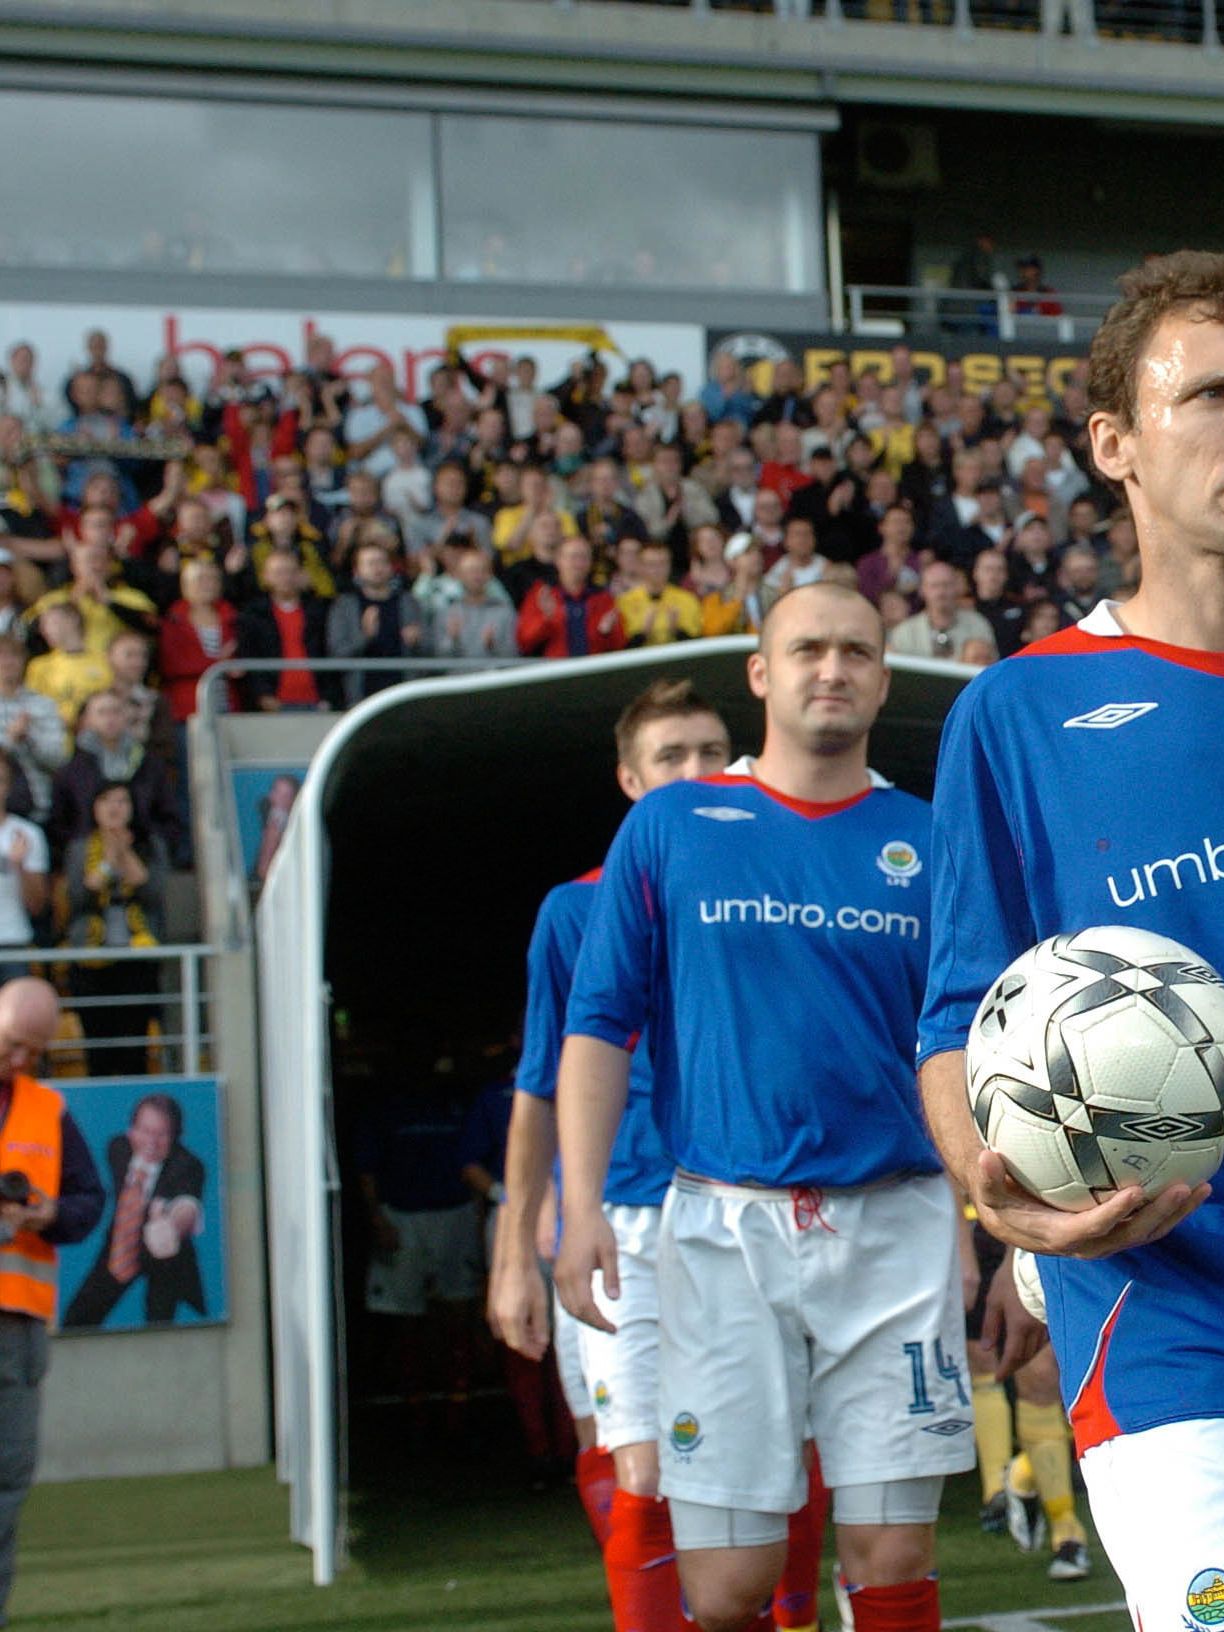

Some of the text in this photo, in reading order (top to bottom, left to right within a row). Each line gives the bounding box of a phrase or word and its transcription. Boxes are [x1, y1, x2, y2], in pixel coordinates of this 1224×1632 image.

[165, 315, 511, 405] haens
[700, 893, 920, 940] umbro.com
[902, 1336, 971, 1415] 14
